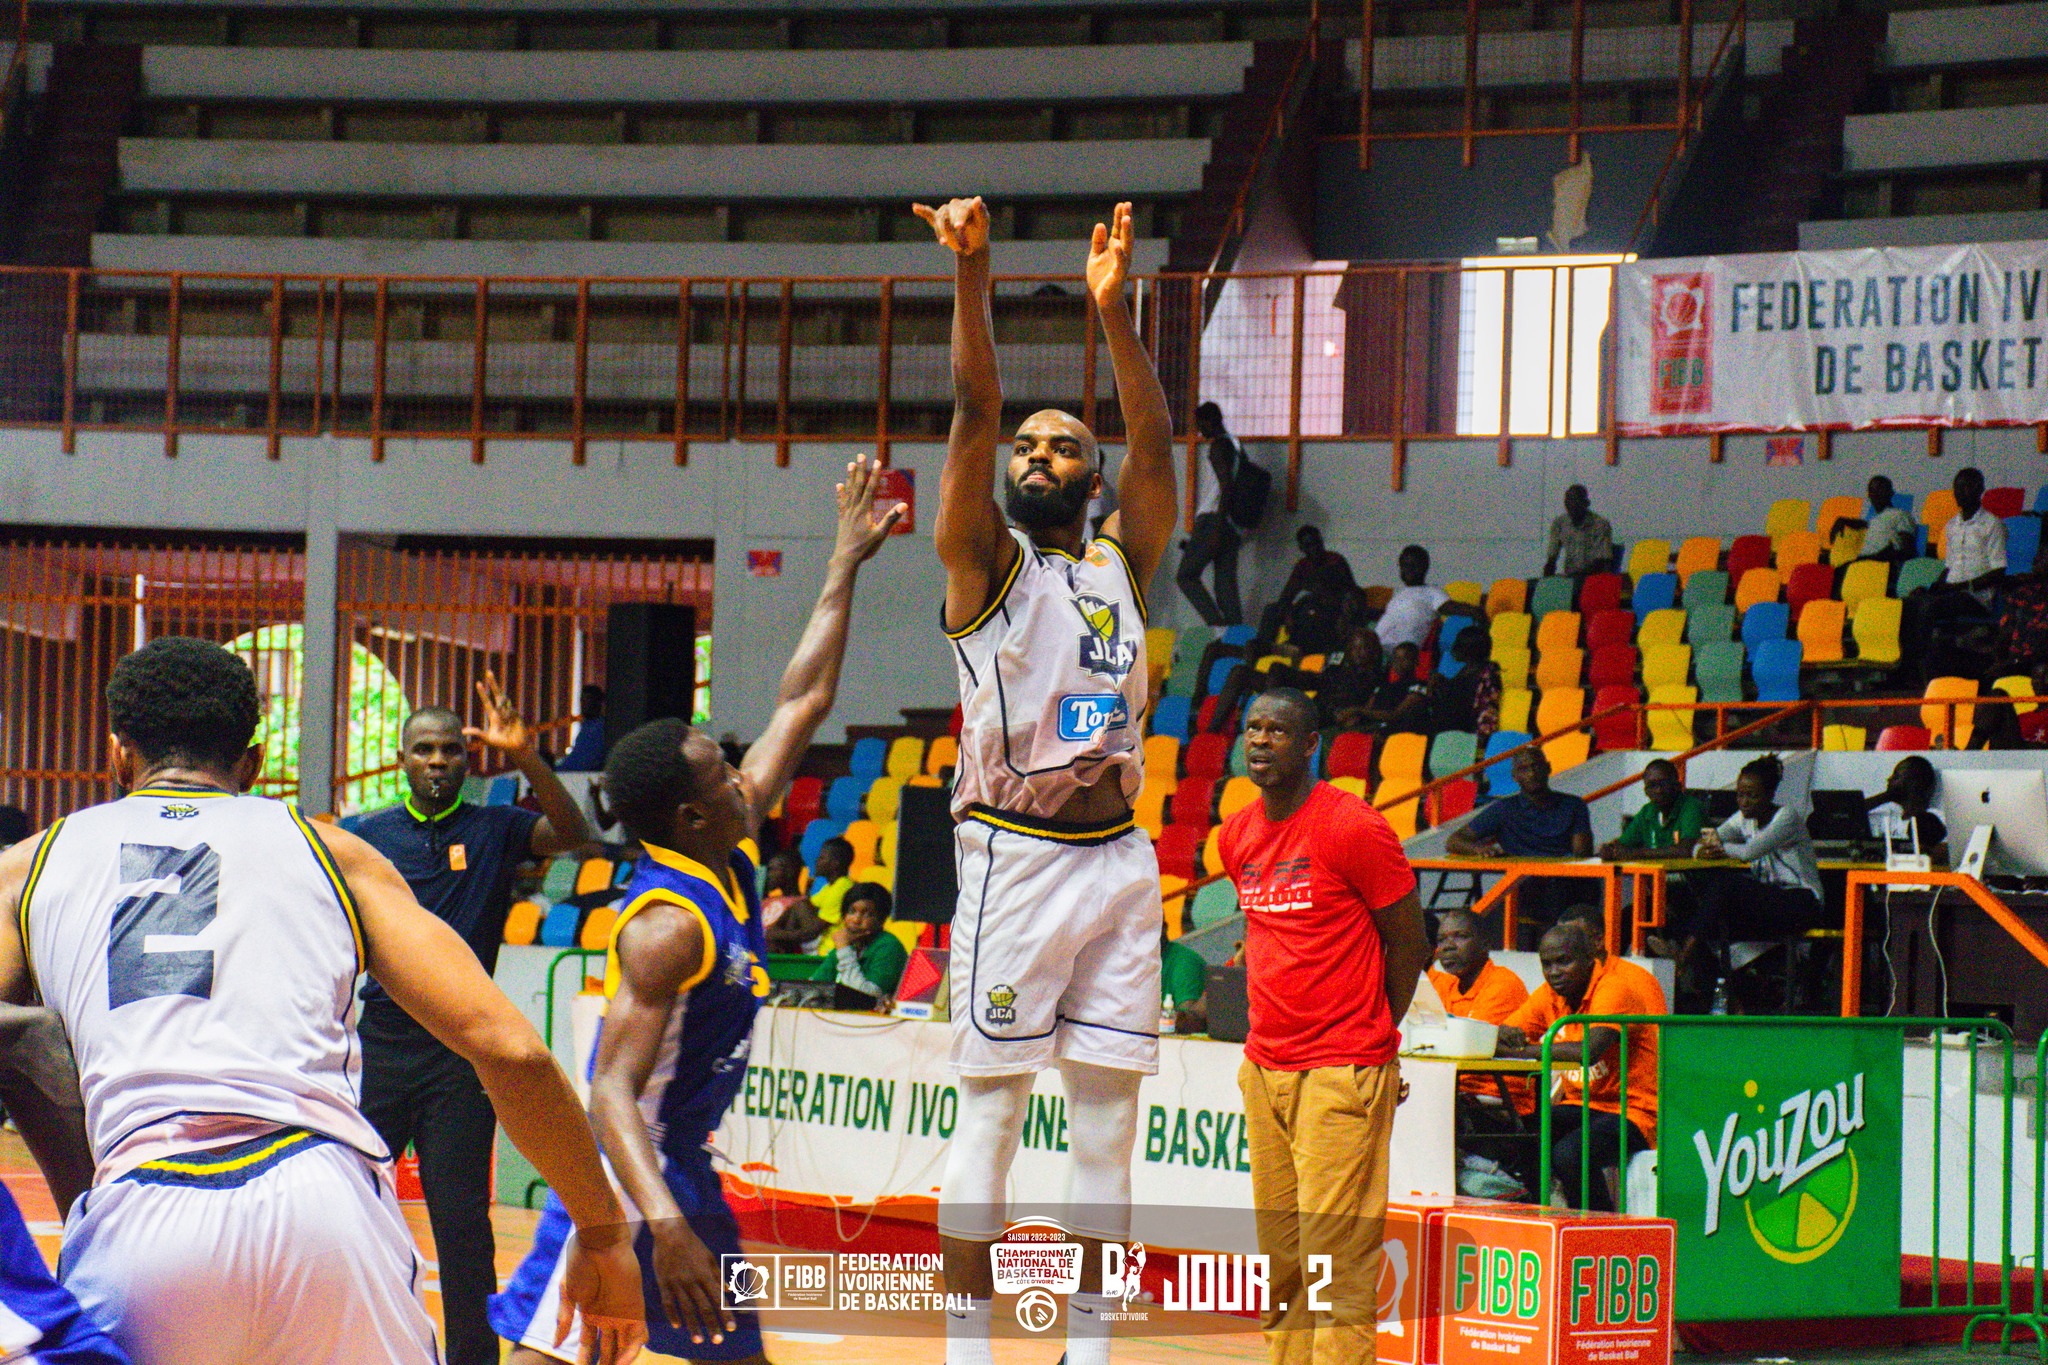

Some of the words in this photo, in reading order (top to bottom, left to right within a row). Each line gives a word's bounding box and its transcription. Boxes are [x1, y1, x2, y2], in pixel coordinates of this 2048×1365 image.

[1731, 272, 1980, 333] FEDERATION
[2002, 269, 2048, 323] IV
[1815, 343, 1864, 395] DE
[1885, 336, 2042, 394] BASKET
[107, 841, 222, 1011] 2
[989, 1008, 1013, 1020] JCA
[731, 1065, 895, 1132] EDERATION
[1145, 1104, 1251, 1173] BASKE
[1455, 1243, 1542, 1320] FIBB
[1571, 1255, 1660, 1326] FIBB
